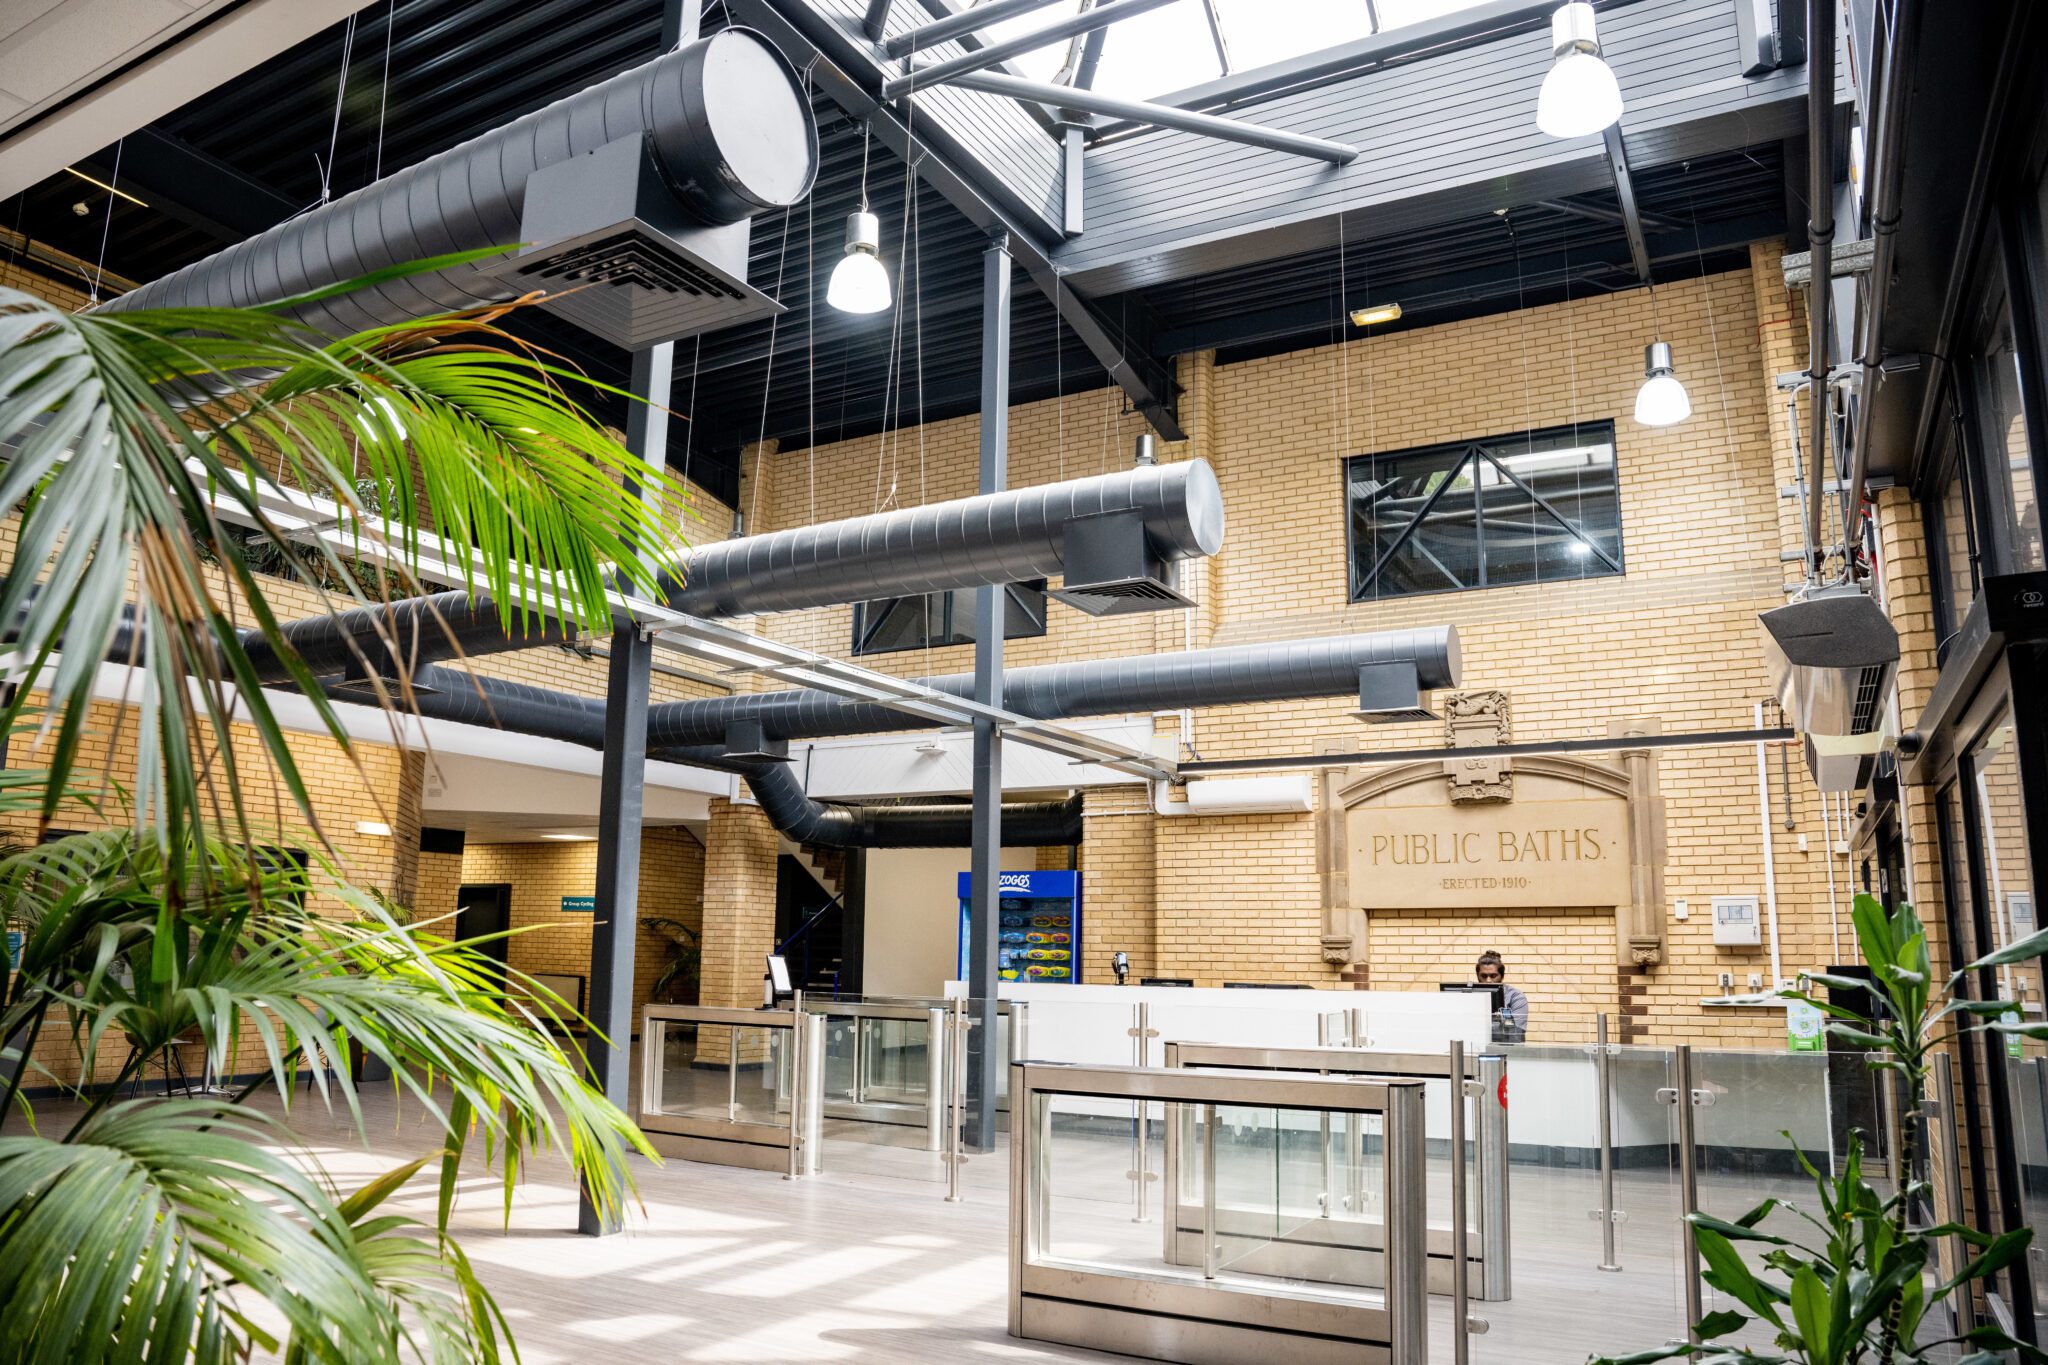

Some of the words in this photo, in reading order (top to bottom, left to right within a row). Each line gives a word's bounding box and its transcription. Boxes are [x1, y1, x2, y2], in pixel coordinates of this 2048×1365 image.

[1371, 832, 1482, 865] PUBLIC
[999, 874, 1030, 887] ZOGGS
[1442, 878, 1498, 889] ERECTED
[1502, 877, 1527, 888] 1910
